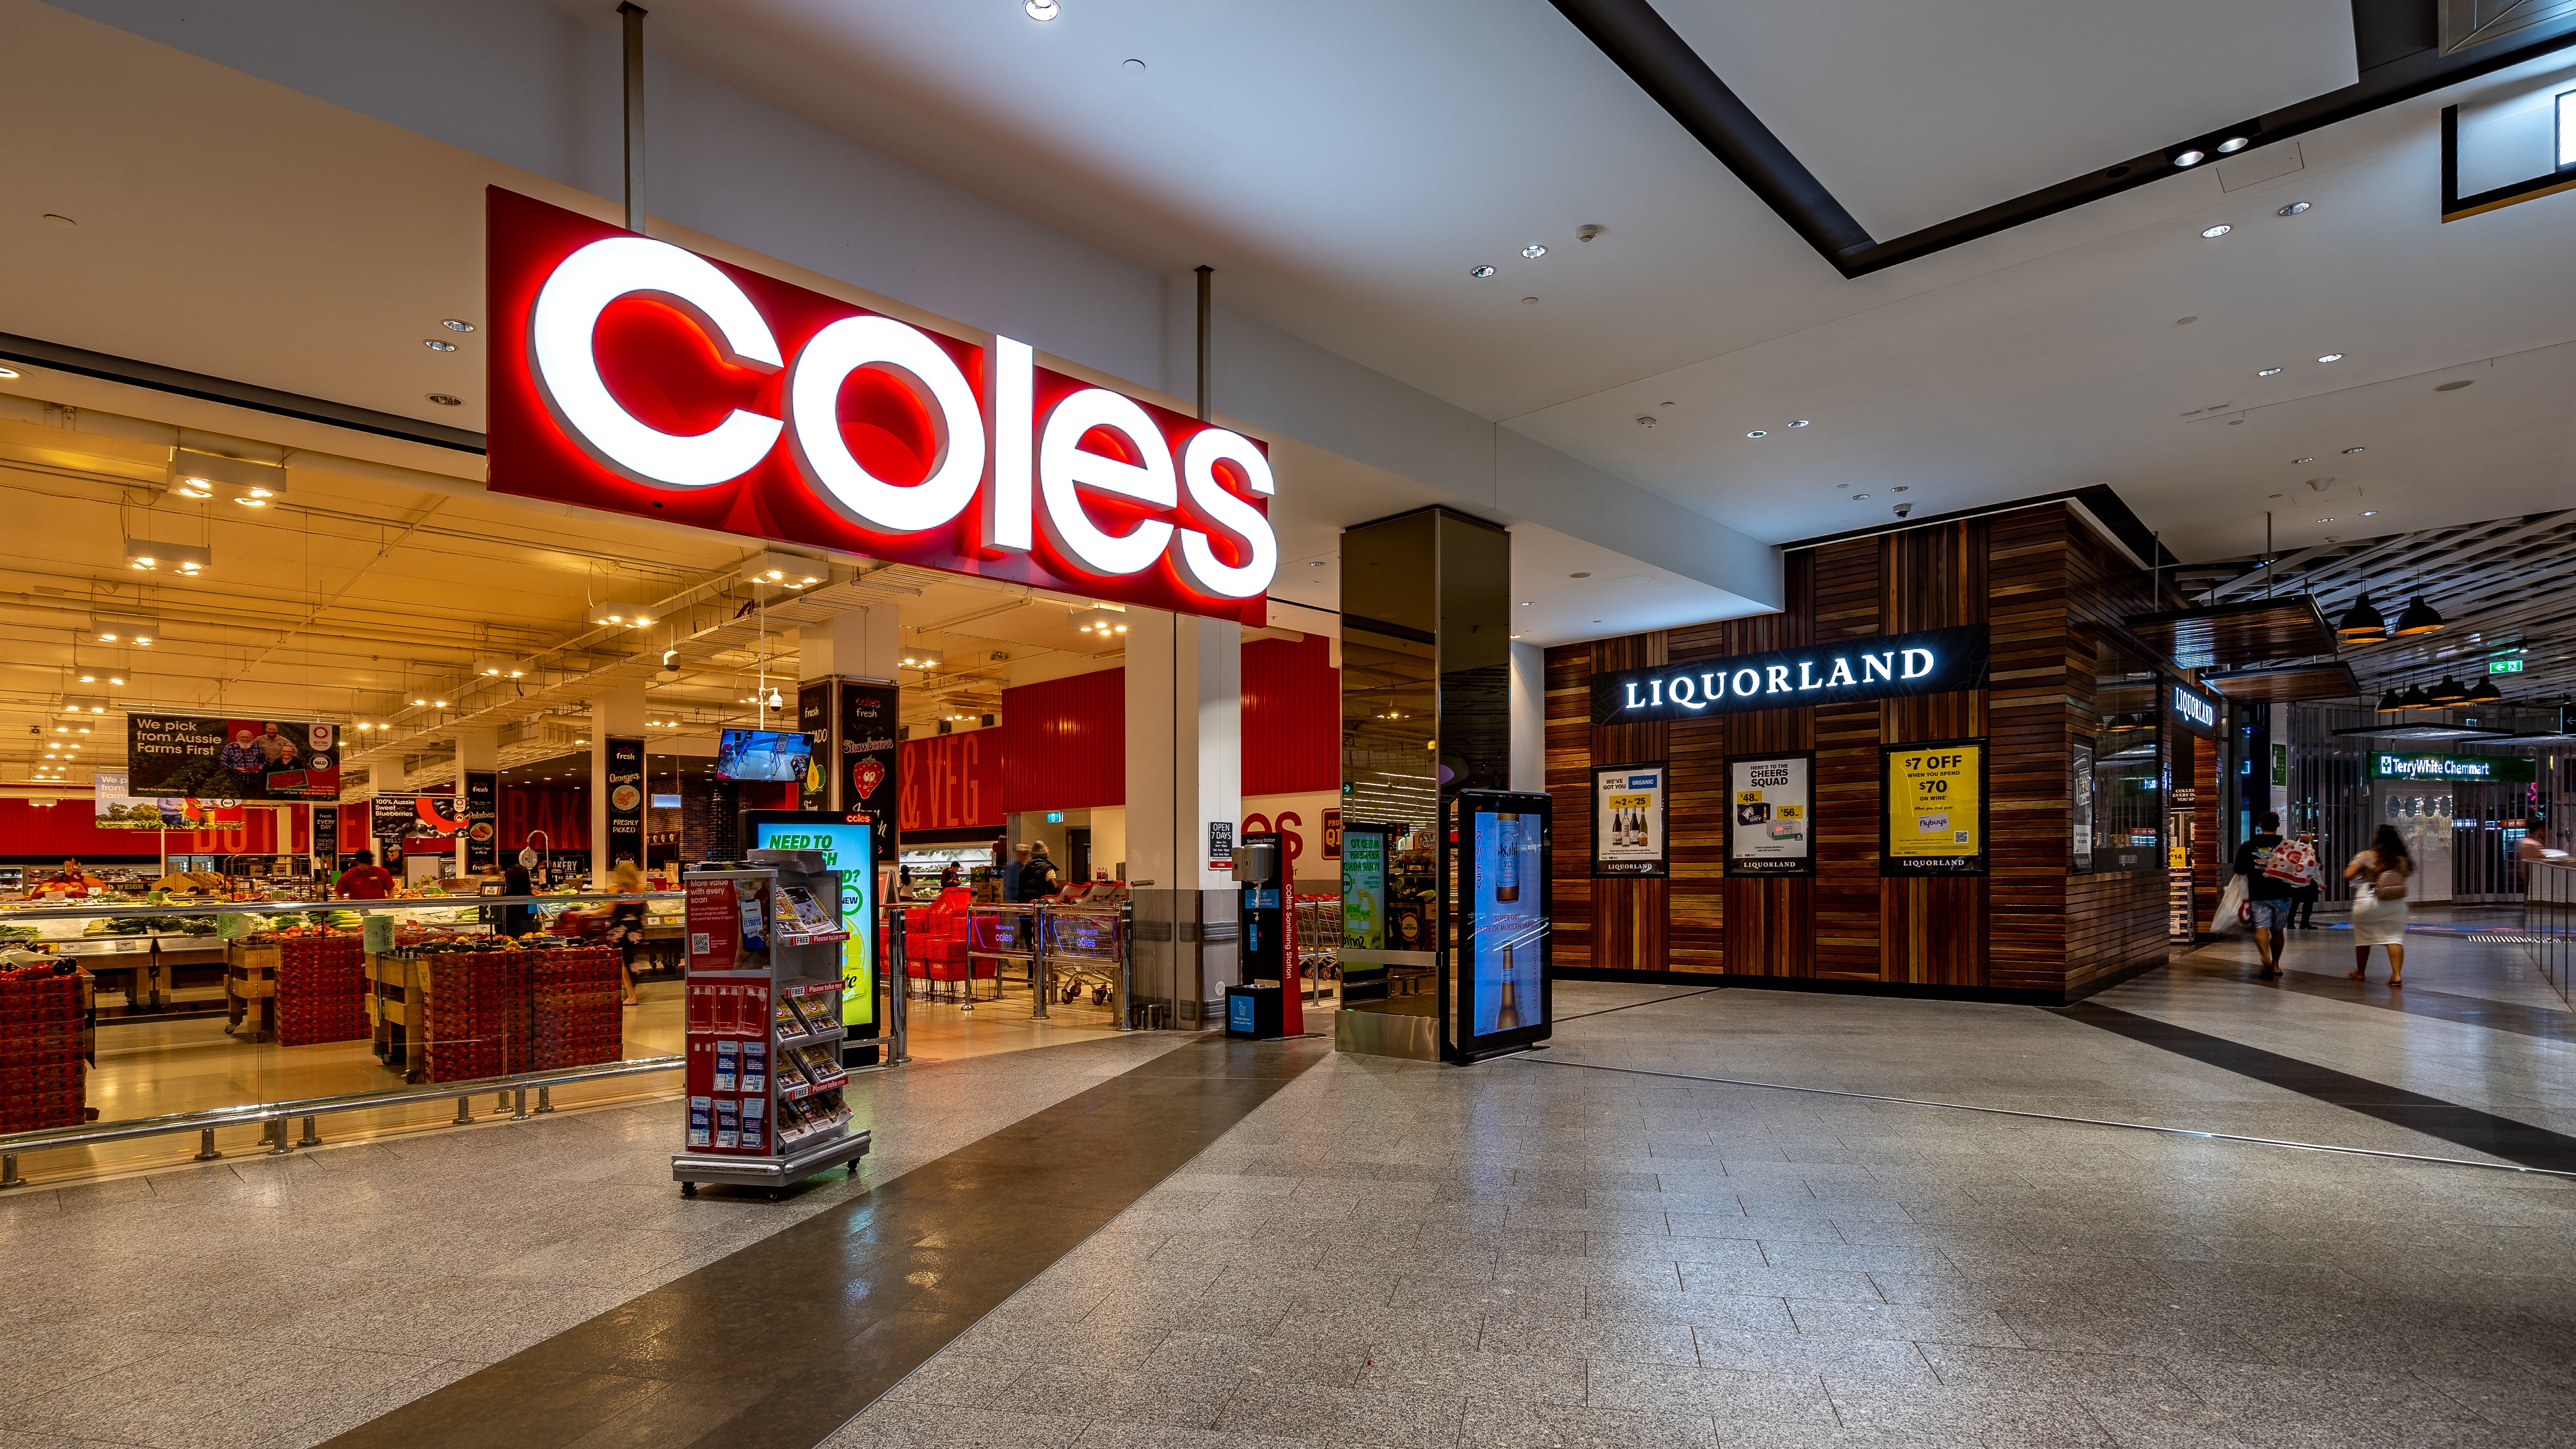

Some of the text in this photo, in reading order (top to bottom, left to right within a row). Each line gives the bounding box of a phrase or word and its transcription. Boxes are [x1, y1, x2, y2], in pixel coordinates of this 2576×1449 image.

[529, 235, 1278, 600] coles
[1625, 647, 1936, 710] LIQUORLAND
[856, 696, 880, 708] coles
[2175, 686, 2213, 727] LIQUORLAND
[804, 706, 819, 718] fresh
[856, 707, 877, 717] fresh
[137, 718, 197, 732] We pick
[137, 731, 222, 744] from Aussie
[137, 743, 215, 755] Farms First
[843, 736, 894, 754] Strawberries
[616, 752, 635, 760] fresh
[1905, 755, 1962, 770] $7 OFF
[2392, 758, 2490, 776] TerryWhite Chemmart
[609, 773, 640, 784] Oranges
[1750, 768, 1789, 778] CHEERS
[901, 733, 979, 829] & VEG
[1750, 777, 1789, 788] SQUAD
[1919, 779, 1948, 793] $70
[468, 811, 495, 820] Potatoes
[846, 814, 870, 823] coles
[1213, 823, 1230, 831] OPEN
[1211, 831, 1232, 840] 7 DAYS
[769, 834, 833, 849] NEED TO
[1503, 860, 1512, 868] 辛口
[706, 888, 725, 896] every
[1285, 884, 1294, 910] coles
[937, 902, 947, 915] coles
[743, 919, 762, 928] FLYBUYS
[1494, 913, 1521, 923] SUPER DRY
[1500, 923, 1522, 932] MODERN
[796, 936, 809, 944] FREE
[995, 933, 1013, 942] coles
[1076, 937, 1096, 947] coles
[792, 988, 804, 996] FREE
[795, 1088, 808, 1097] FREE
[813, 1084, 828, 1093] Please
